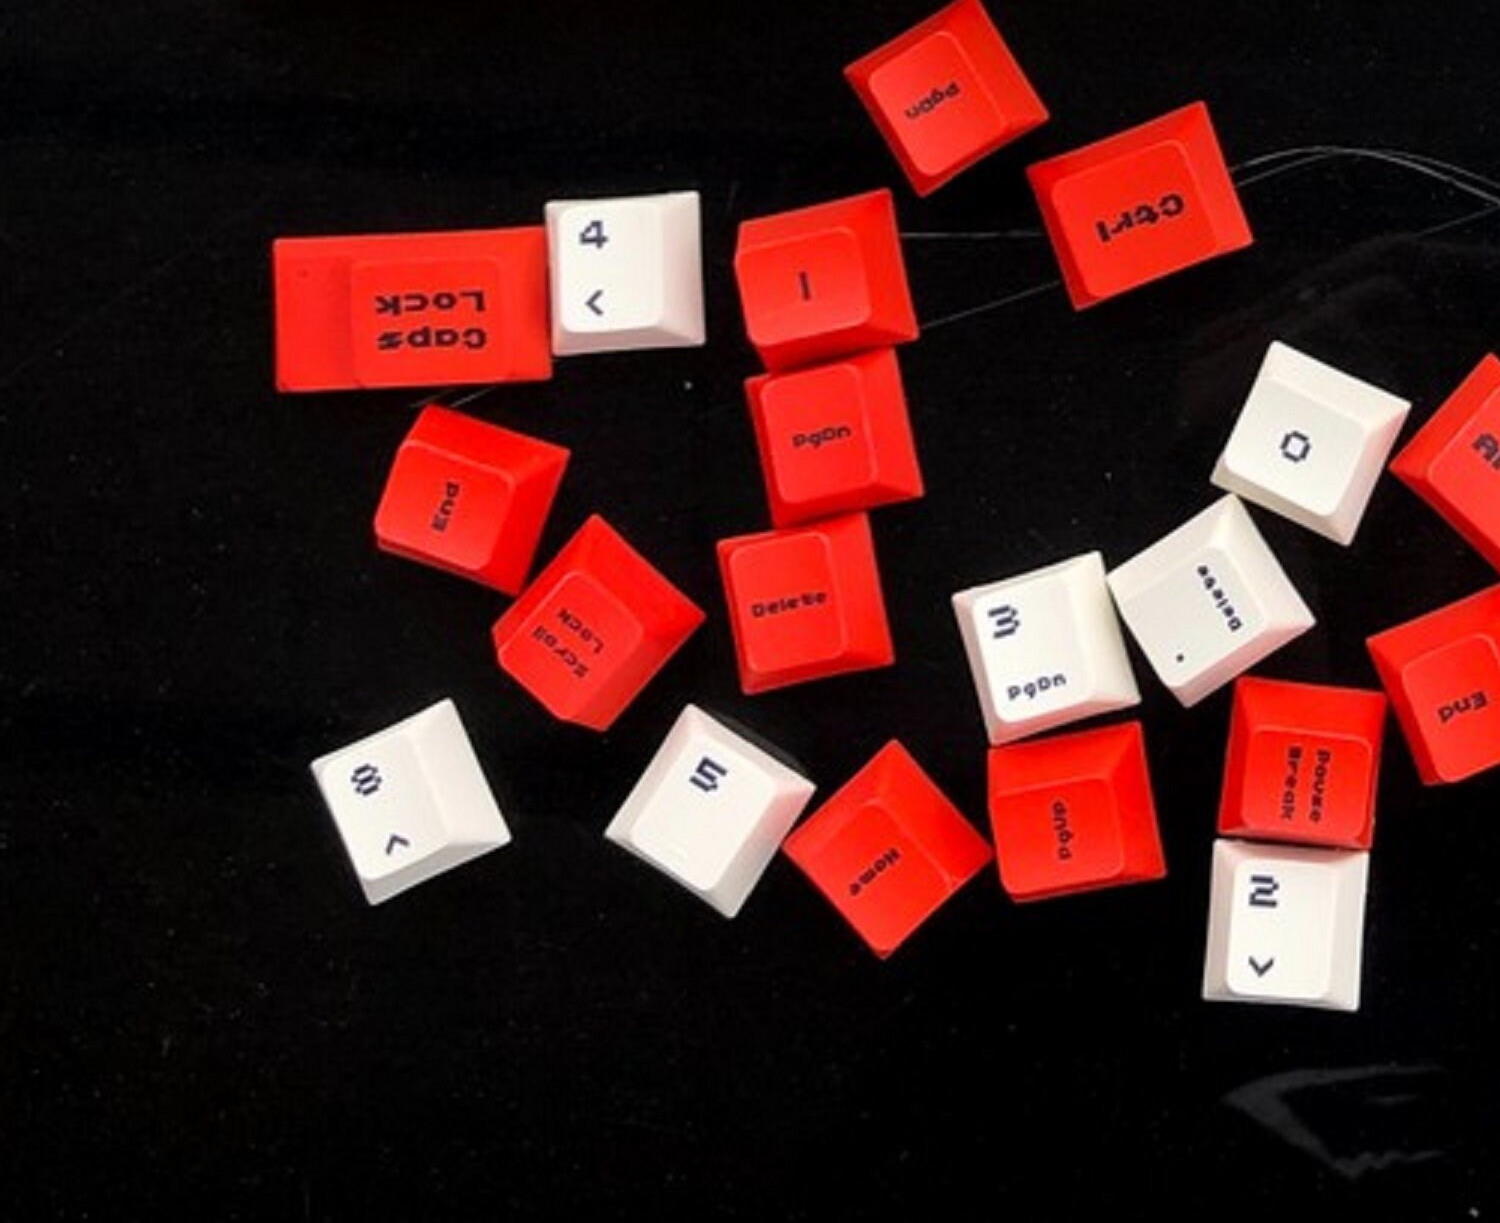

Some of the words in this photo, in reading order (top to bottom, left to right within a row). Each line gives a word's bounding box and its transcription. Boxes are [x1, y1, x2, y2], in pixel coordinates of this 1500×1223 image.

[906, 82, 960, 117] PgDn
[1095, 192, 1185, 242] Ctrl
[580, 221, 607, 248] 4
[376, 291, 485, 315] Lock
[378, 327, 486, 350] Caps
[793, 426, 851, 448] PgDn
[430, 482, 459, 534] End
[752, 593, 826, 617] Delete
[988, 605, 1019, 638] 3
[558, 608, 604, 655] Lock
[1008, 674, 1066, 700] PgDn
[1436, 691, 1488, 722] End
[351, 764, 381, 795] 8
[690, 758, 727, 792] 5
[1280, 746, 1302, 820] Break
[1306, 749, 1330, 826] Pause
[1052, 801, 1073, 864] PgUp
[848, 848, 900, 898] Home
[1249, 876, 1279, 907] 2
